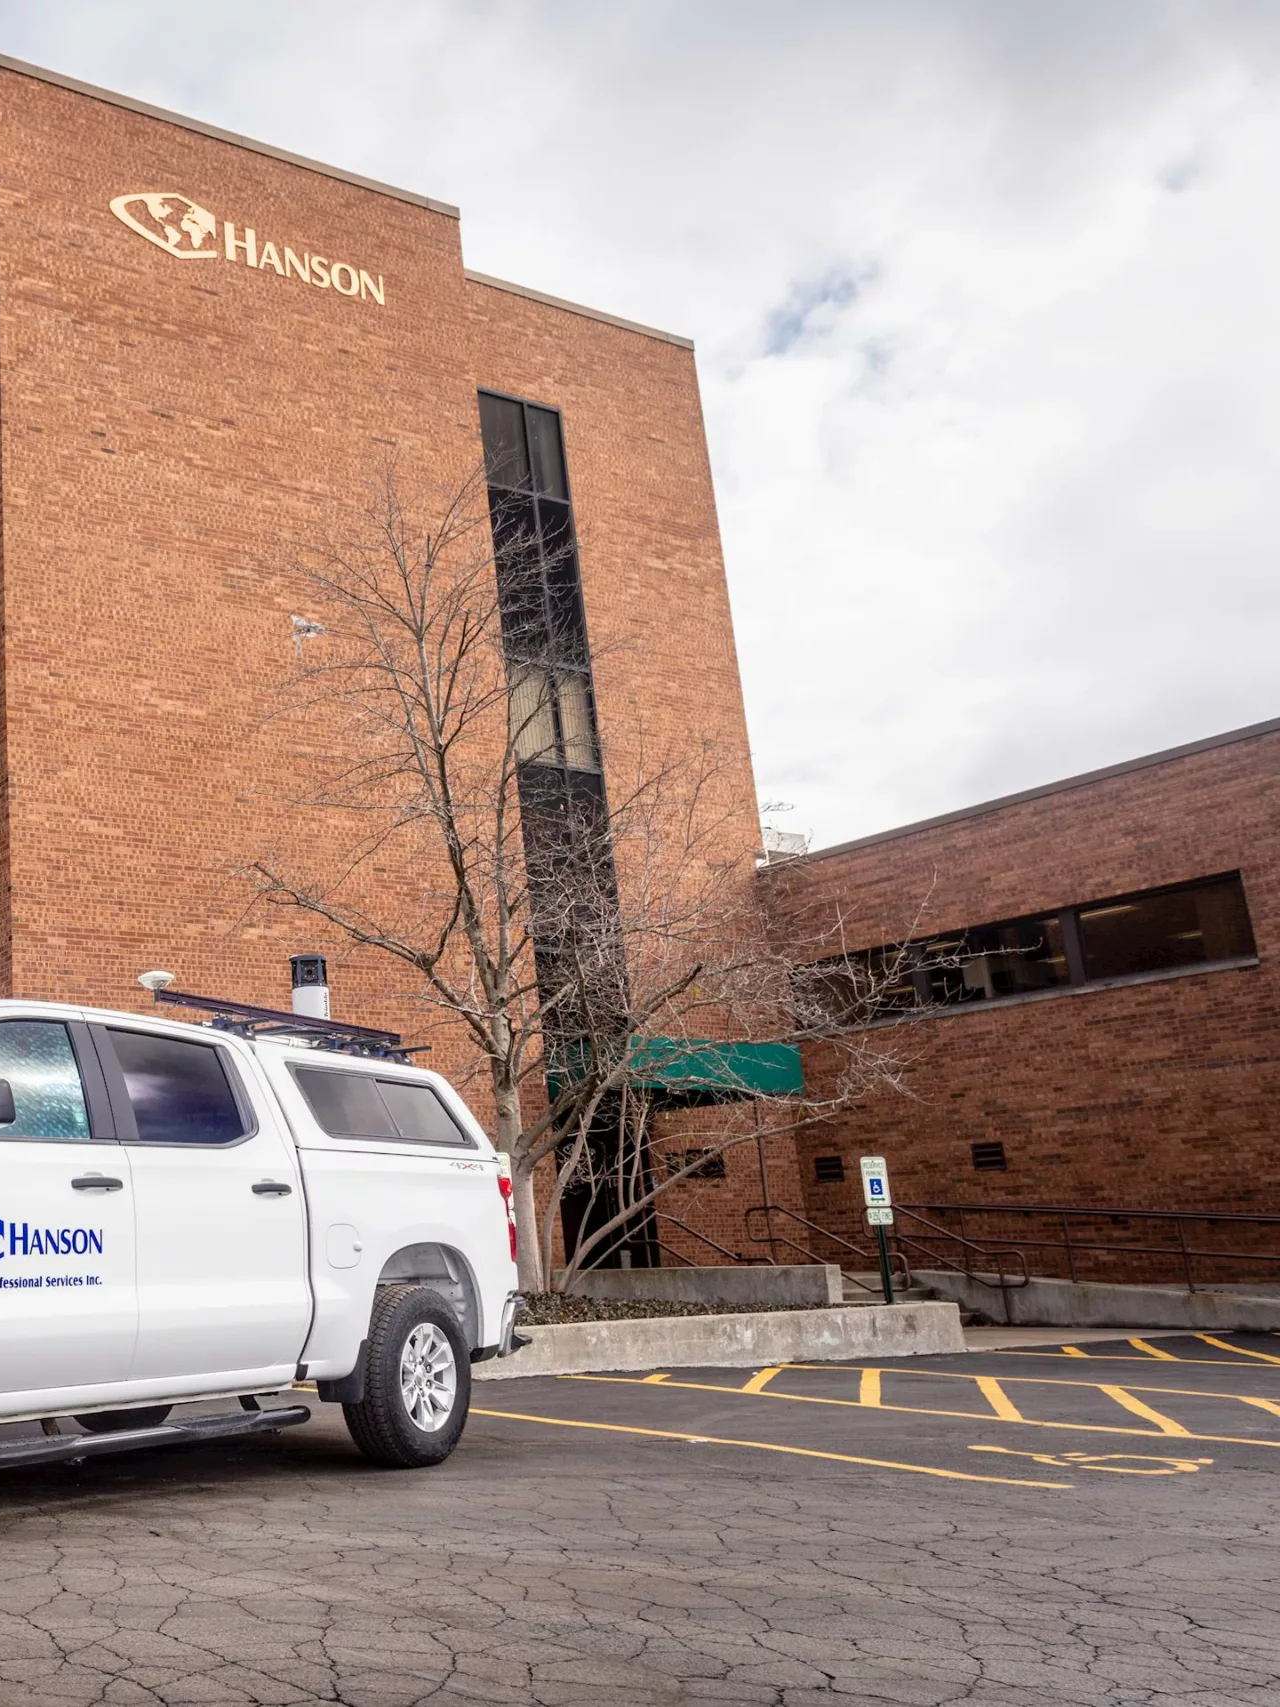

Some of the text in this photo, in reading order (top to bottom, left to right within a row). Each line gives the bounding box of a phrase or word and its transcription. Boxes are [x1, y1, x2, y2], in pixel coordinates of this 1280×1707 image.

[224, 221, 385, 305] HANSON
[10, 1223, 103, 1255] HANSON
[46, 1276, 83, 1287] Services
[87, 1275, 103, 1286] Inc.
